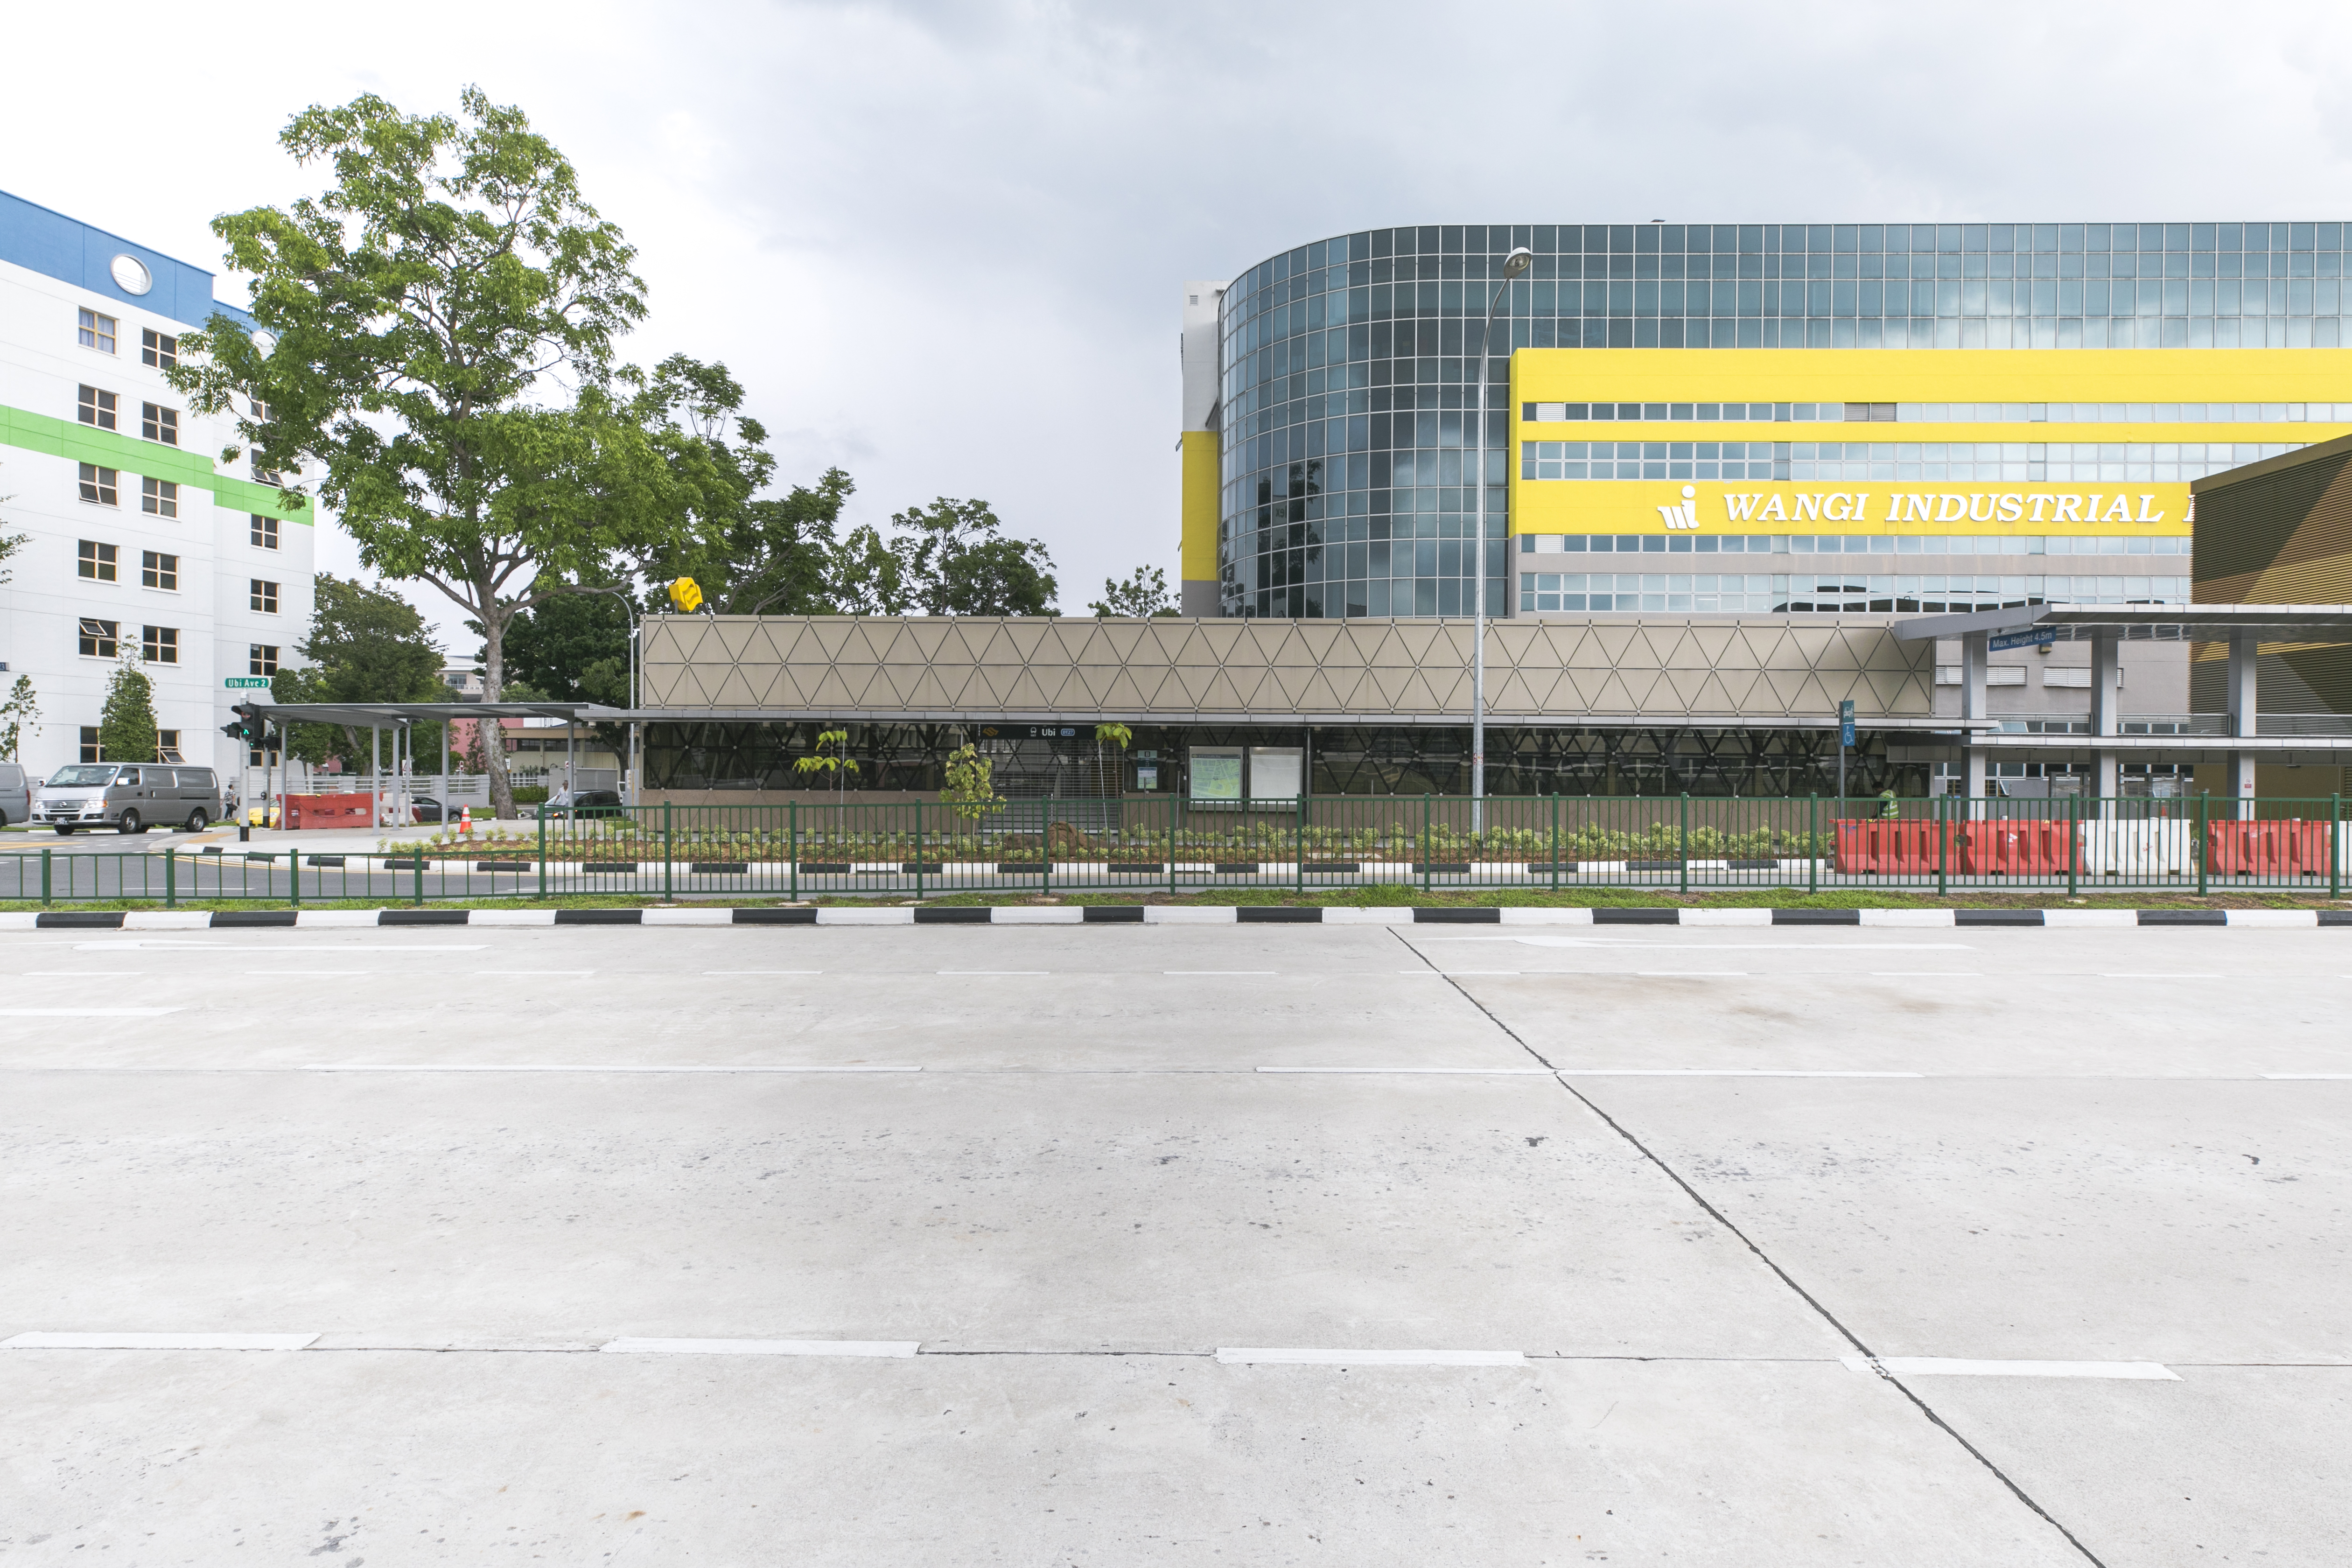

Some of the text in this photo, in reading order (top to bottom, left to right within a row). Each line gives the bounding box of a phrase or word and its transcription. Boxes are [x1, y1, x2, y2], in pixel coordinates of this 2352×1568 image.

[1724, 493, 1869, 521] WANGI
[1885, 493, 2164, 522] INDUSTRIAL
[1993, 632, 2052, 648] Max. Height 4.5m
